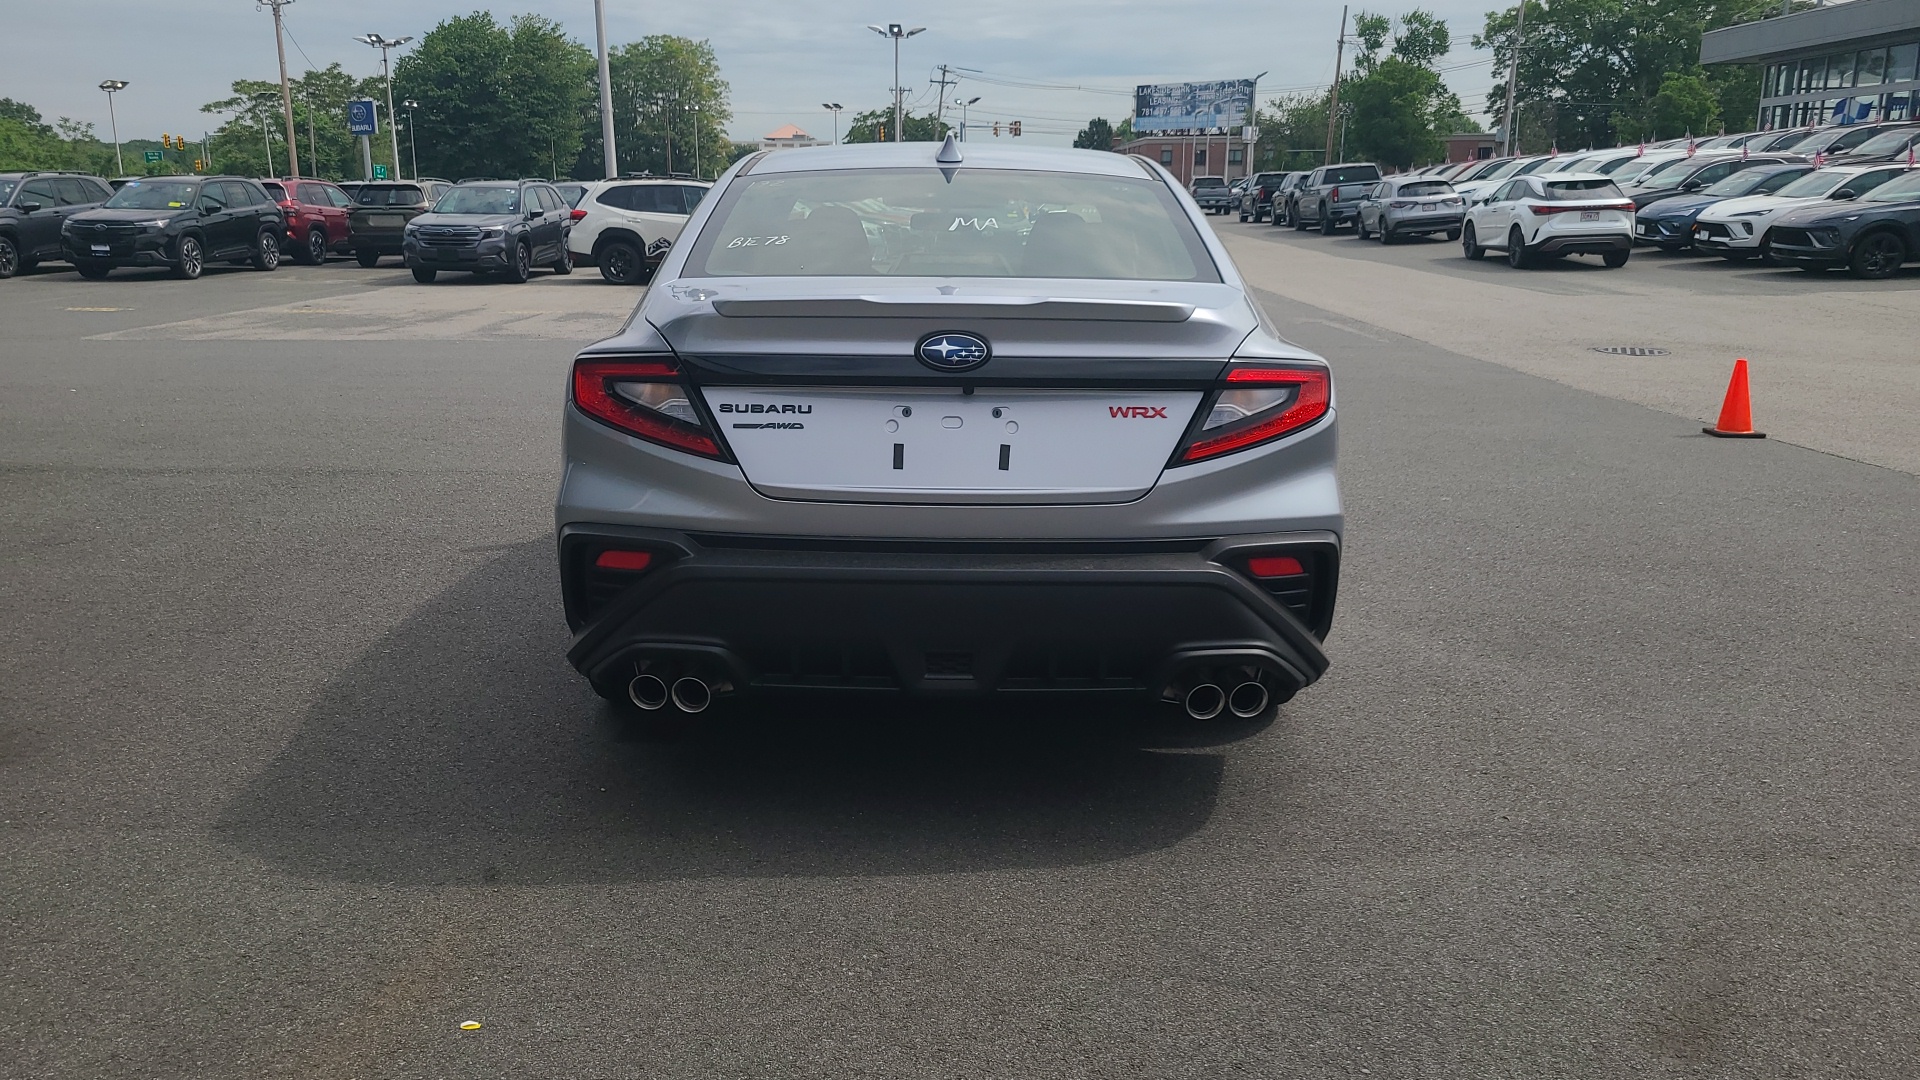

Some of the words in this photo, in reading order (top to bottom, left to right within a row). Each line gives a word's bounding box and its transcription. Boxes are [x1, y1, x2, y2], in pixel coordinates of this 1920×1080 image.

[1139, 86, 1171, 96] LAKESIDE
[351, 124, 372, 132] SUBARU
[948, 217, 999, 231] MA
[764, 235, 791, 246] 78
[719, 403, 812, 414] SUBARU
[1108, 406, 1168, 419] WRX
[759, 422, 804, 430] AWD
